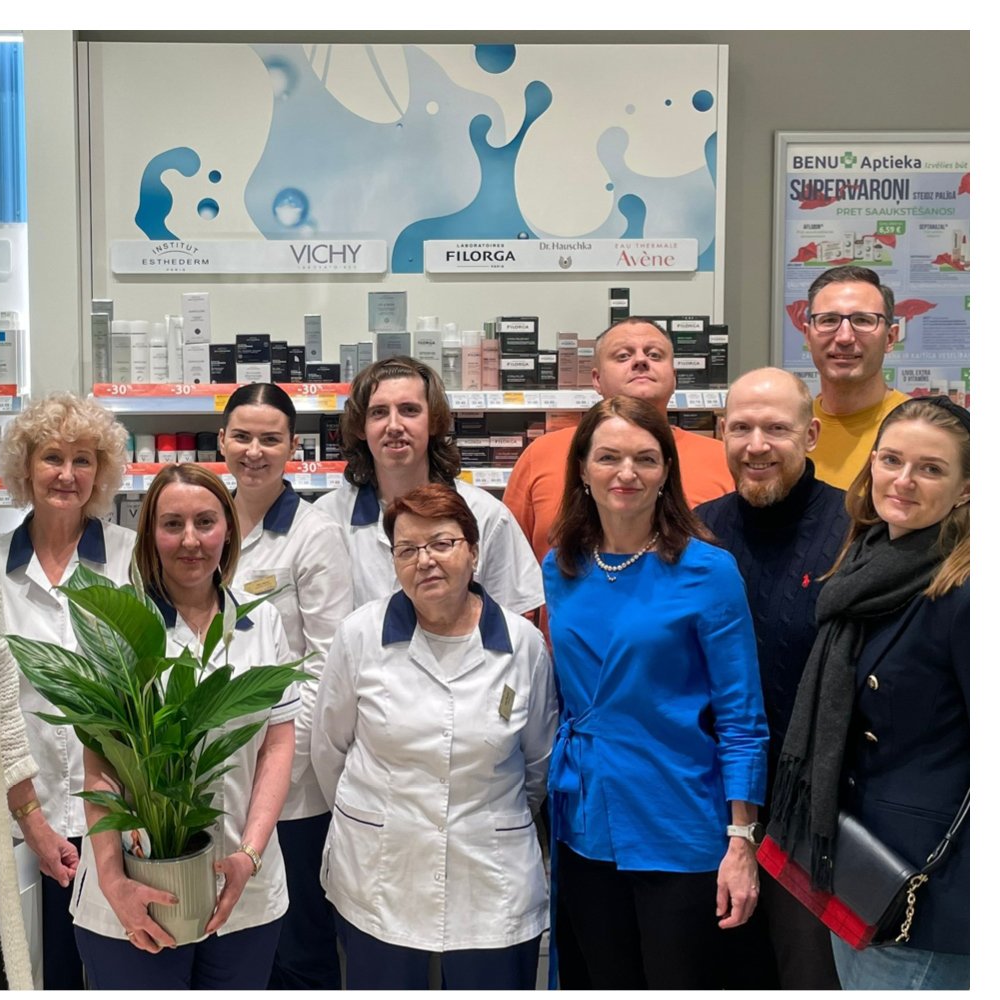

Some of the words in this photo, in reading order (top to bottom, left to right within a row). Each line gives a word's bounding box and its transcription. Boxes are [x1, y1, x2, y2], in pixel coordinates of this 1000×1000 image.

[792, 155, 839, 169] BENU
[860, 155, 922, 171] Aptieka
[790, 178, 910, 205] SUPERVAROŅI
[836, 207, 862, 216] PRET
[151, 241, 200, 255] INSTITUT
[289, 244, 362, 264] VICHY
[445, 250, 516, 262] FILORGA
[616, 249, 676, 267] Avène
[141, 258, 210, 266] ESTHEDERM
[106, 384, 133, 395] -30%
[171, 384, 197, 395] -30%
[297, 384, 323, 395] -30%
[297, 462, 323, 473] -30%
